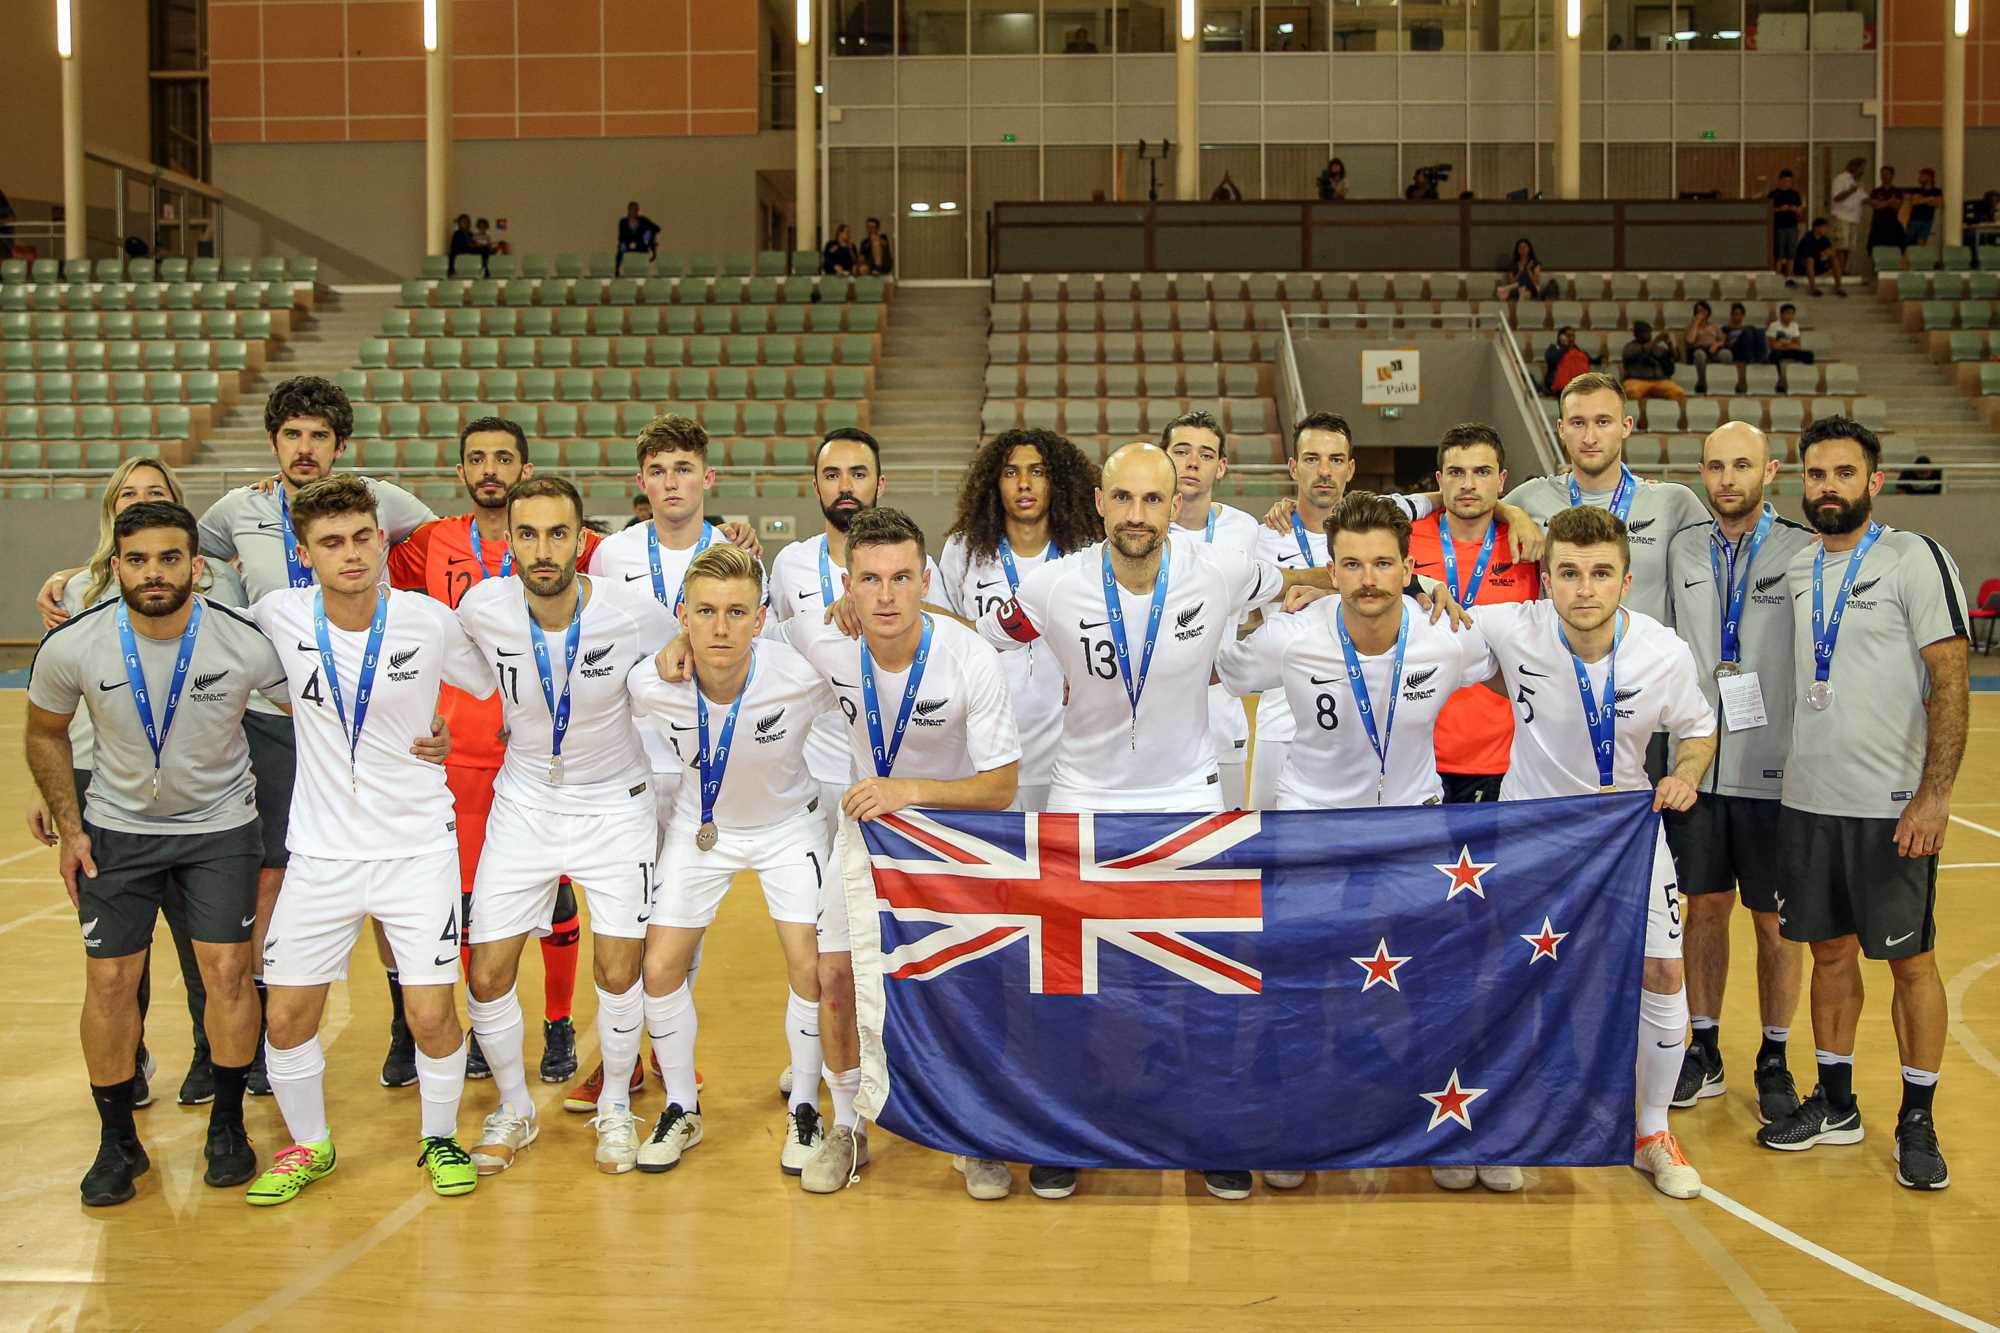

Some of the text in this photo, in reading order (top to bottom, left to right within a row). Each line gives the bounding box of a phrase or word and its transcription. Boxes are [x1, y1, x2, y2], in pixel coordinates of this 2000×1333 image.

[445, 571, 472, 609] 12
[1080, 637, 1117, 680] 13
[301, 666, 324, 707] 4
[496, 662, 519, 705] 11
[1517, 684, 1535, 724] 5
[1316, 693, 1338, 731] 8
[439, 903, 459, 946] 4
[1664, 883, 1680, 925] 5
